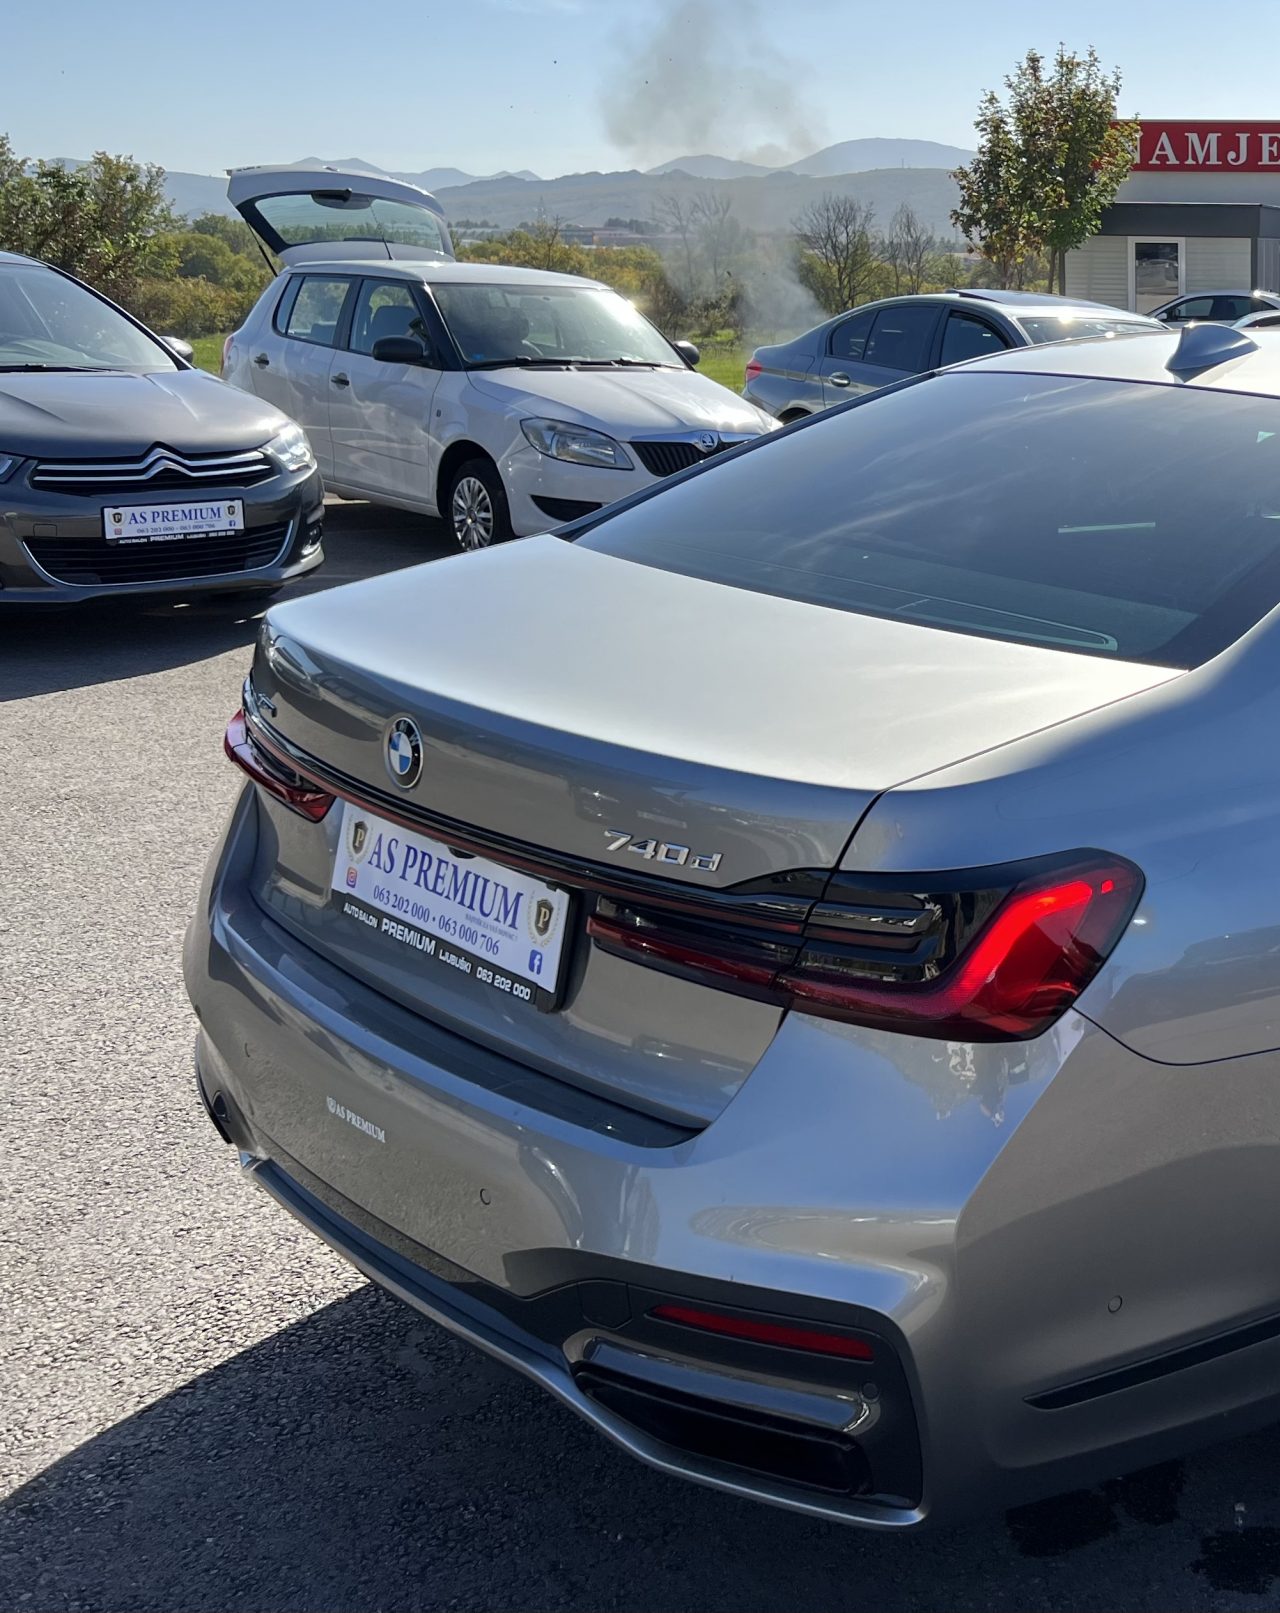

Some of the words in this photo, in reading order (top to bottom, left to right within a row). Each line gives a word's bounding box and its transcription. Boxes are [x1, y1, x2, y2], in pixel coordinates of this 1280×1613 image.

[128, 511, 147, 525] AS
[152, 507, 222, 523] PREMIUM
[150, 533, 184, 542] PREMIUM
[604, 830, 723, 872] 740d
[367, 833, 399, 874] AS
[399, 844, 524, 930] PREMIUM
[373, 885, 390, 905] 063
[391, 894, 410, 914] 202
[411, 902, 430, 923] 000
[439, 914, 457, 936] 063
[459, 923, 478, 946] 000
[480, 934, 499, 956] 706
[381, 917, 436, 955] PREMIUM
[476, 966, 493, 984] 063
[494, 974, 512, 992] 202
[512, 983, 531, 1001] 000
[336, 1103, 346, 1119] AS
[346, 1109, 386, 1143] PREMIUM
